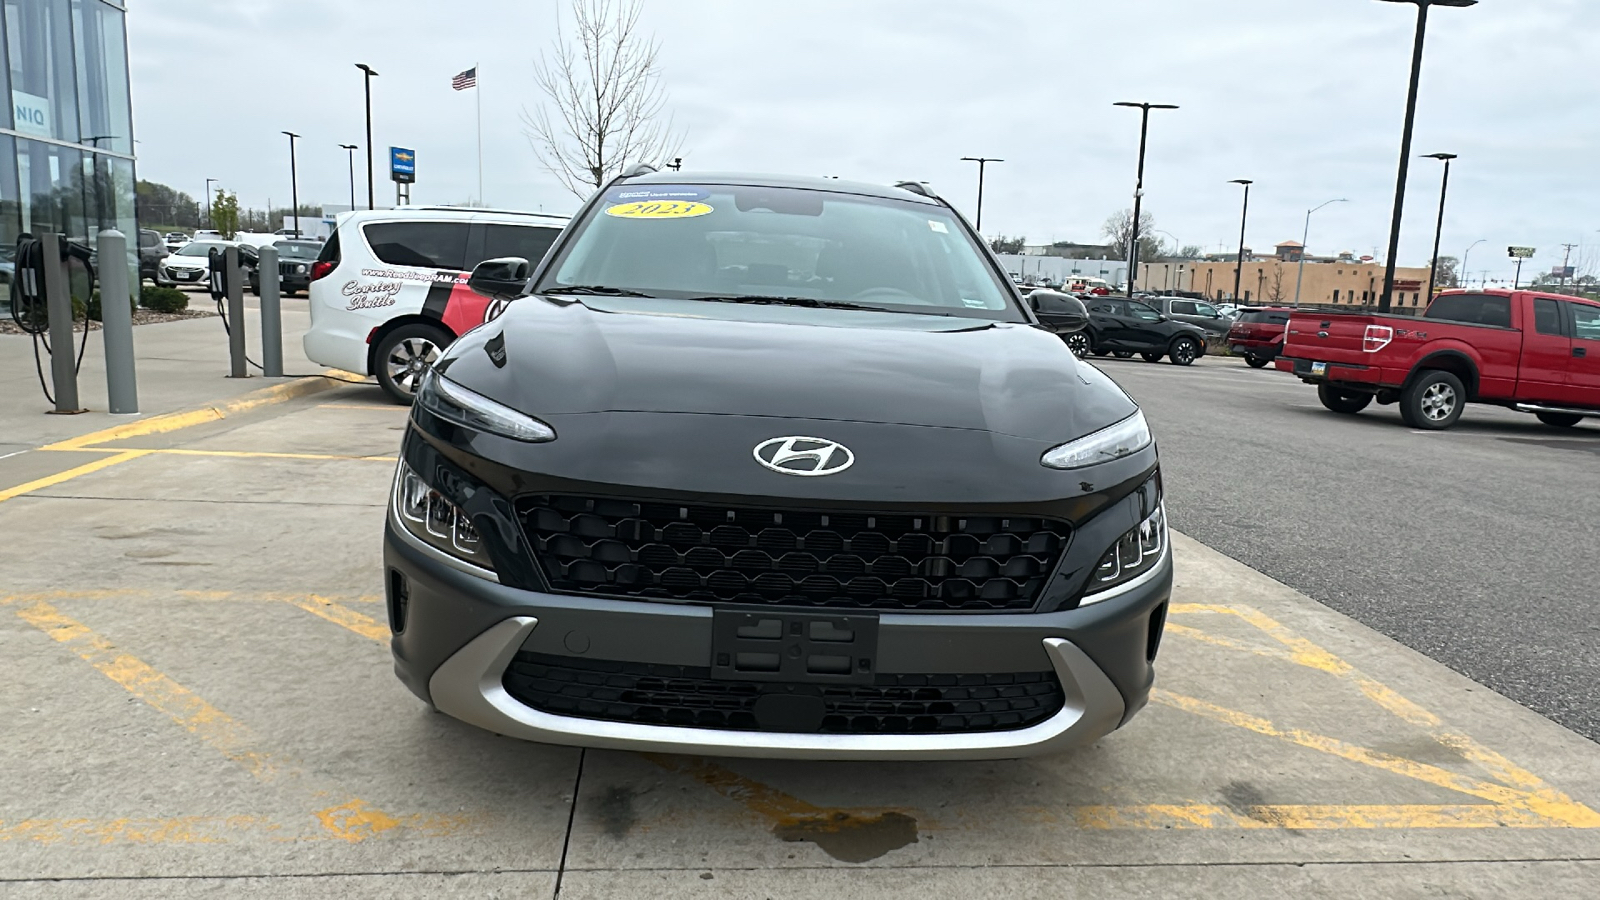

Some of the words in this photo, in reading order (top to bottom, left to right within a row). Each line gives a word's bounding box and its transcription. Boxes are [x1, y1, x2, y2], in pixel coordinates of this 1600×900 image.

[621, 203, 696, 214] 2023
[342, 280, 402, 295] Courtesy
[346, 294, 396, 310] Shuttle
